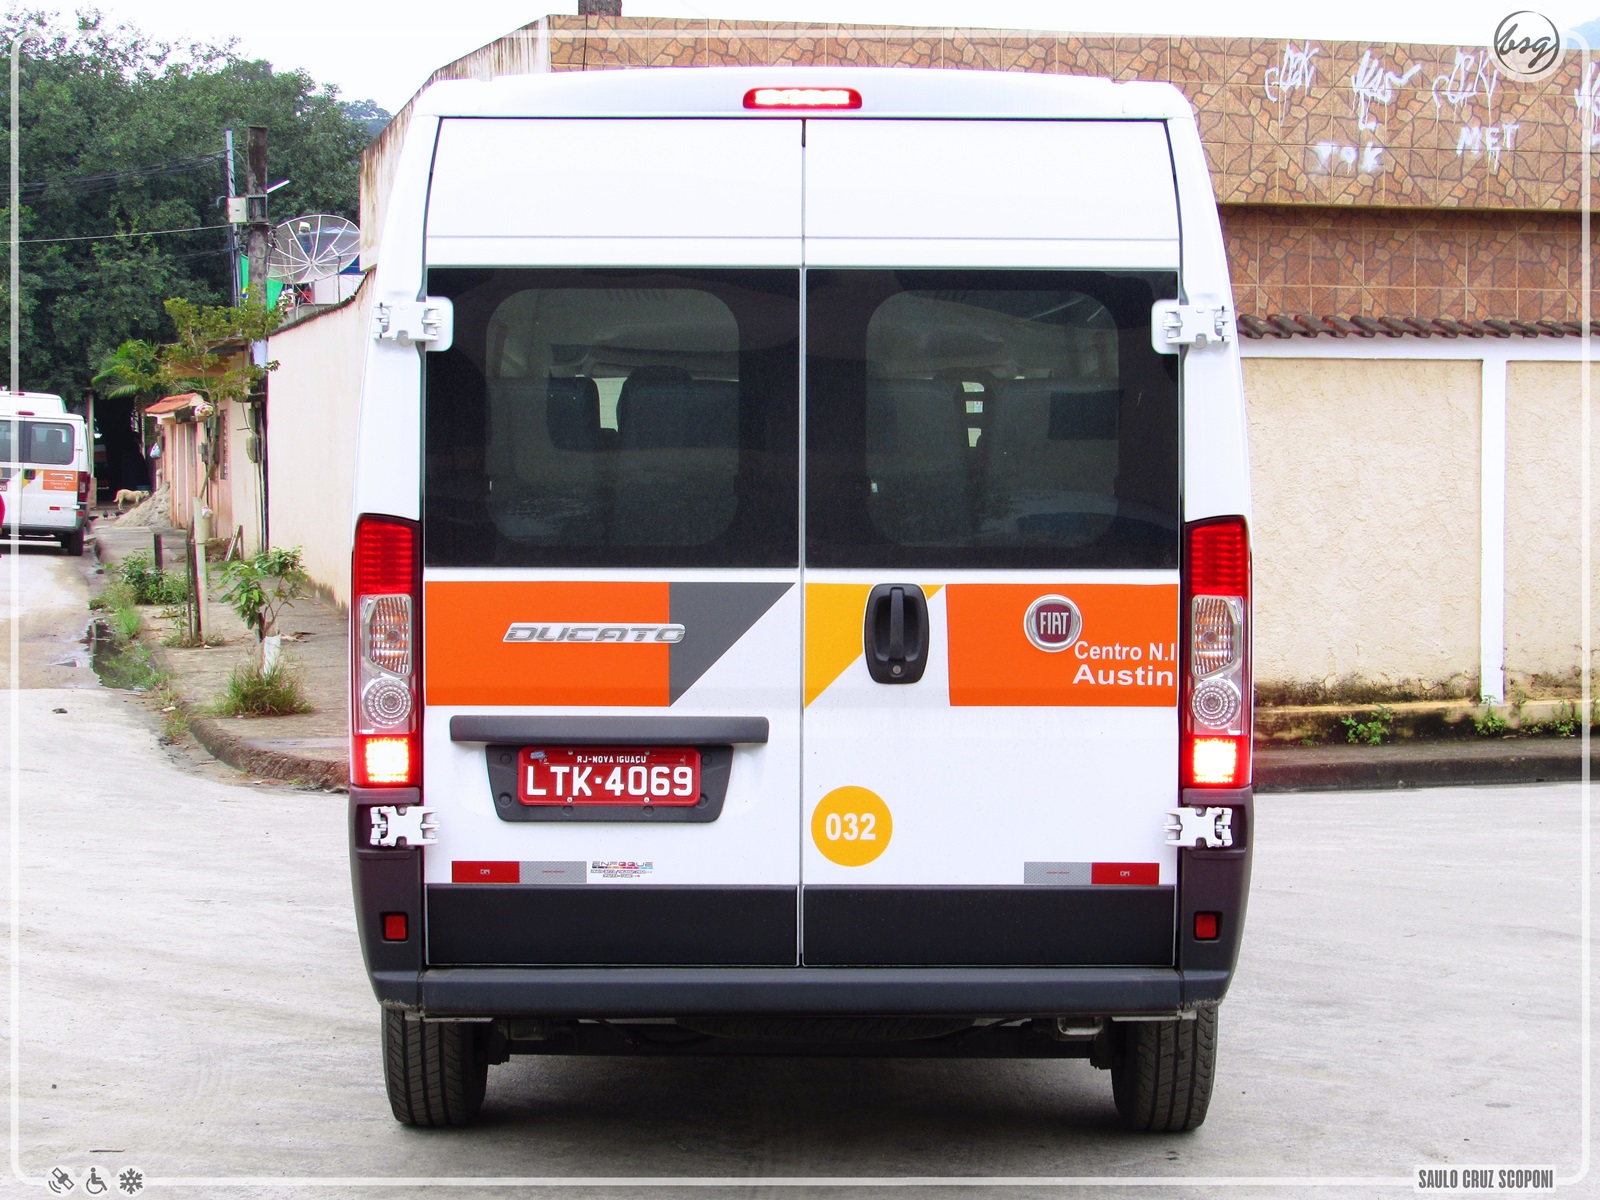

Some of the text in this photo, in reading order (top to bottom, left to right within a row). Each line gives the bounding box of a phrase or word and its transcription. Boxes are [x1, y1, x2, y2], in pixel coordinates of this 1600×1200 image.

[504, 626, 686, 642] DUCATO
[1040, 612, 1069, 635] FIAT
[1074, 641, 1143, 660] Centro
[1072, 664, 1174, 687] Austin
[825, 812, 877, 841] 032
